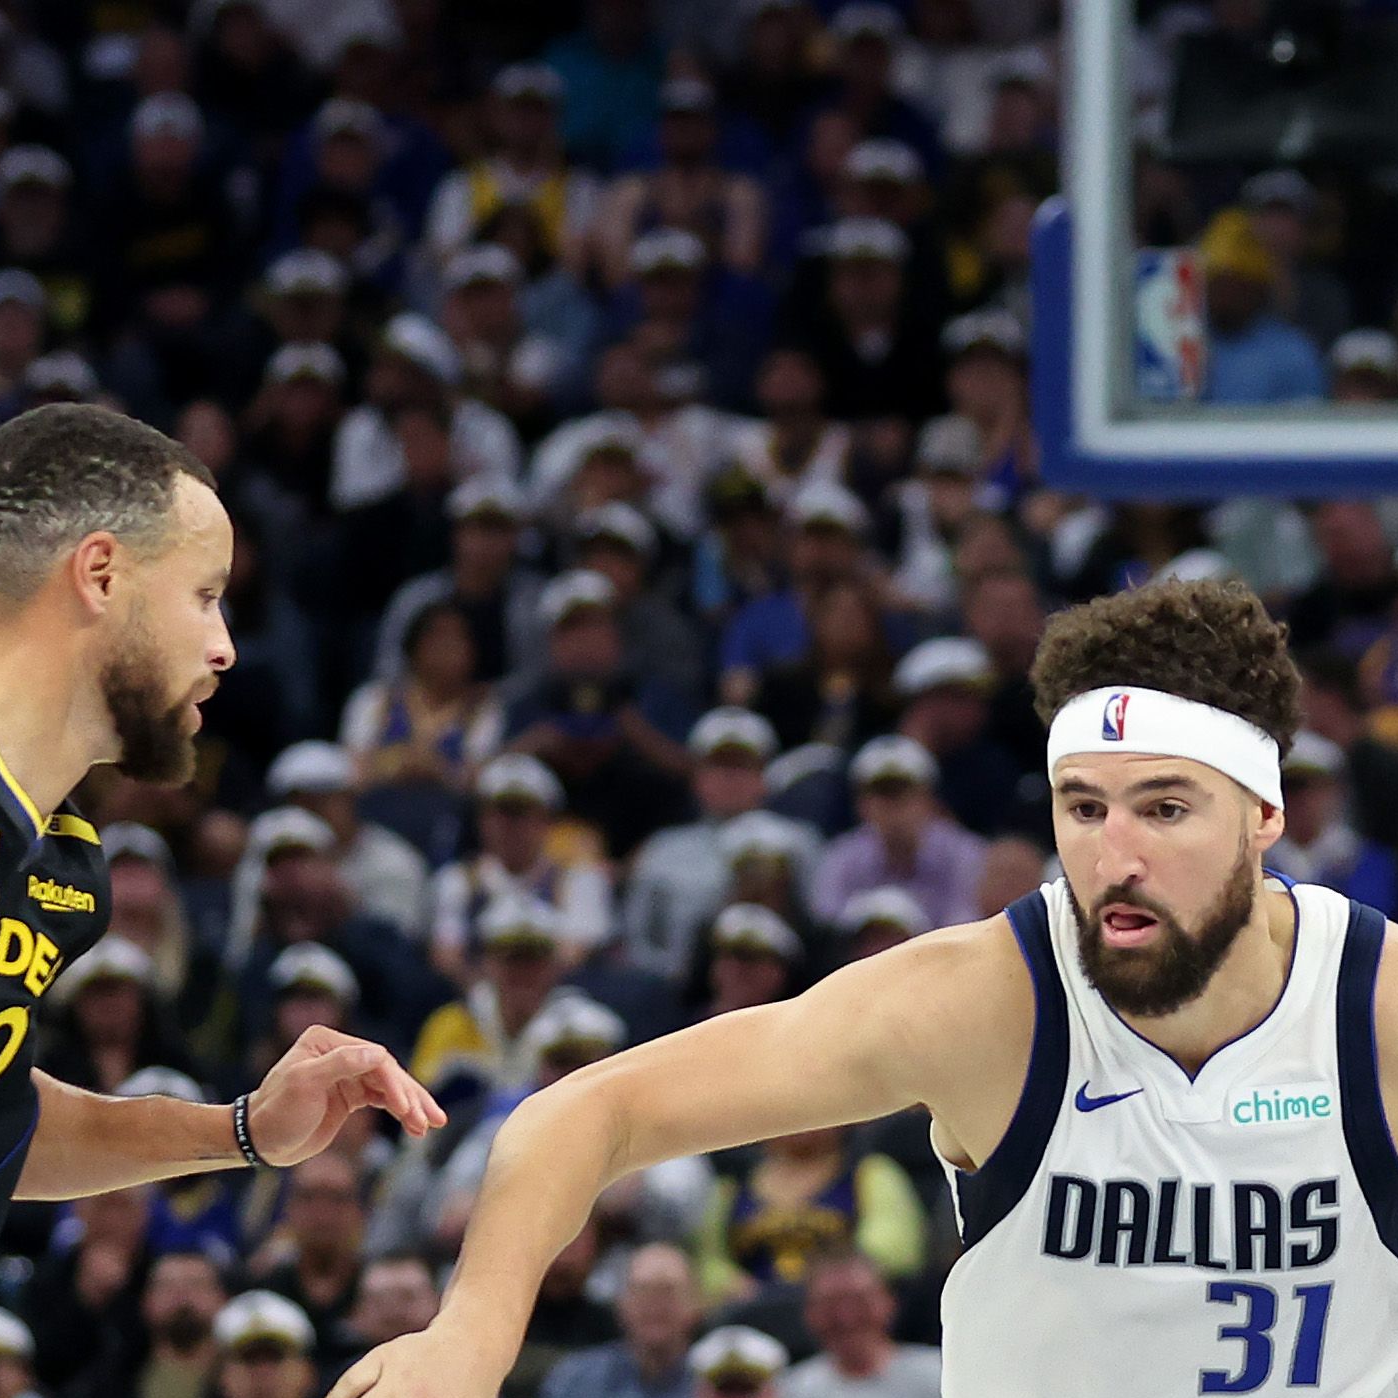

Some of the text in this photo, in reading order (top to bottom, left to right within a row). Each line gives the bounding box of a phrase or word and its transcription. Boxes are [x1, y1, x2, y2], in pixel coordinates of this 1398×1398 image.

[27, 874, 95, 914] Rakuten
[1233, 1089, 1331, 1124] chime
[1040, 1172, 1341, 1273] DALLAS
[1198, 1279, 1335, 1396] 31
